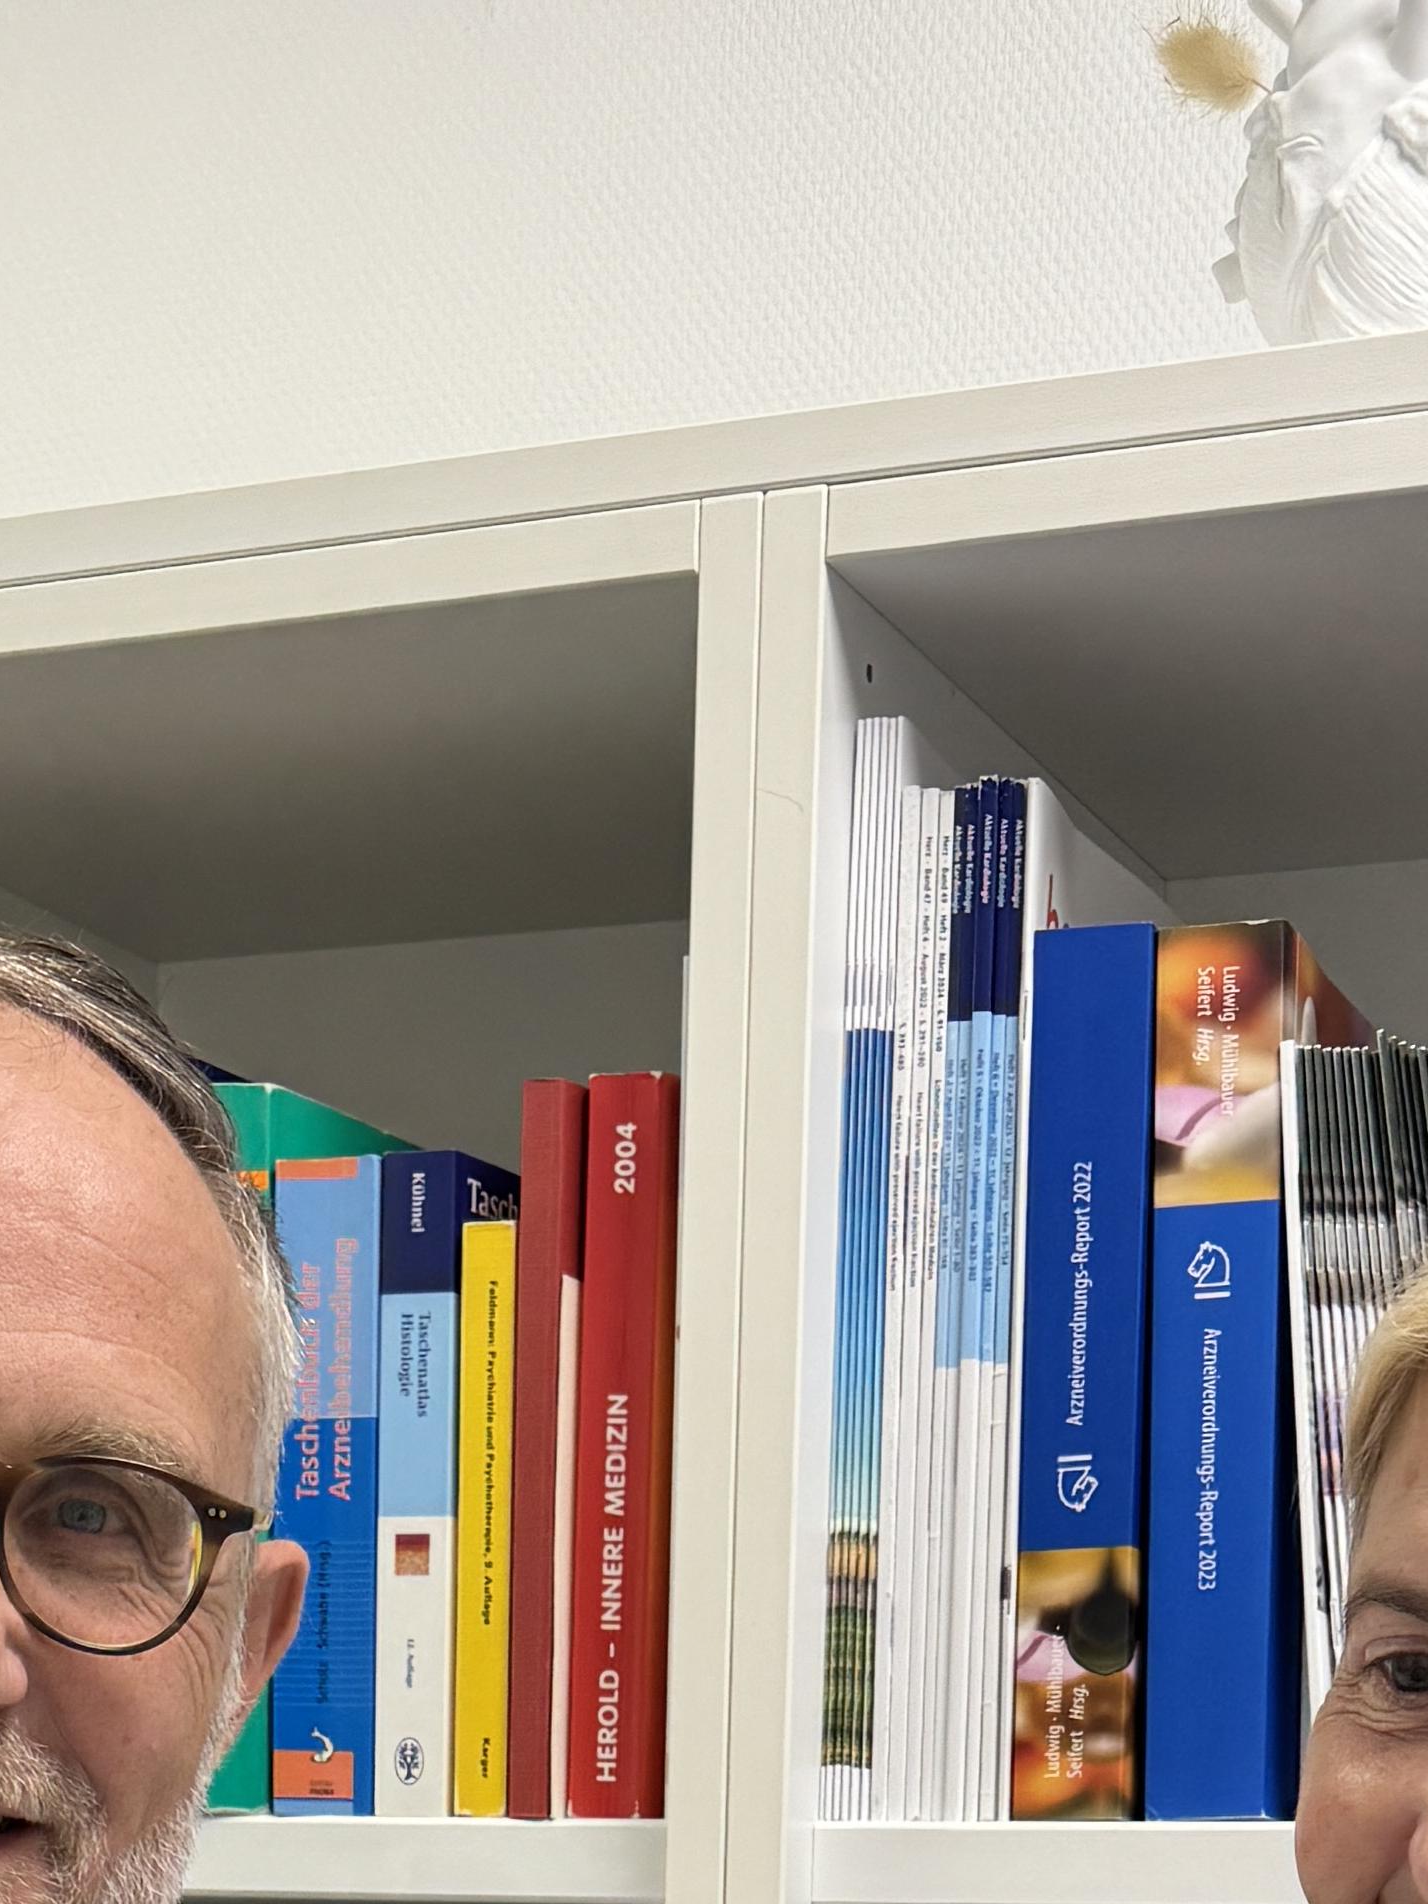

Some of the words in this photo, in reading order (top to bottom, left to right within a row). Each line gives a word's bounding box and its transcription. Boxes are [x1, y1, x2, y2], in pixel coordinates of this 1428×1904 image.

[1196, 966, 1214, 1017] Seifert
[1218, 964, 1239, 1022] Ludwig
[1192, 1027, 1213, 1066] Hrsg.
[1219, 1033, 1239, 1116] Mühlbauer
[611, 1121, 639, 1194] 2004
[1073, 1160, 1093, 1203] 2022
[410, 1172, 425, 1232] Kühnel
[298, 1261, 321, 1311] der
[1065, 1206, 1094, 1426] Arzneiverordnungs-Report
[324, 1237, 360, 1501] Arzneibehandlung
[396, 1312, 415, 1397] Histologie
[415, 1310, 432, 1417] Taschenatlas
[484, 1350, 498, 1424] Psychiatrie
[295, 1316, 325, 1501] Taschenbuch
[484, 1425, 495, 1450] und
[1195, 1327, 1221, 1546] Arzneiverordnungs-Report
[601, 1392, 634, 1516] MEDIZIN
[598, 1525, 628, 1631] INNERE
[1197, 1549, 1217, 1591] 2023
[1045, 1634, 1064, 1713] Mühlbauer
[1069, 1682, 1089, 1720] Hrsg.
[478, 1736, 491, 1779] Karger
[593, 1668, 623, 1783] HEROLD
[1043, 1724, 1065, 1779] Ludwig
[1067, 1730, 1084, 1779] Seifert
